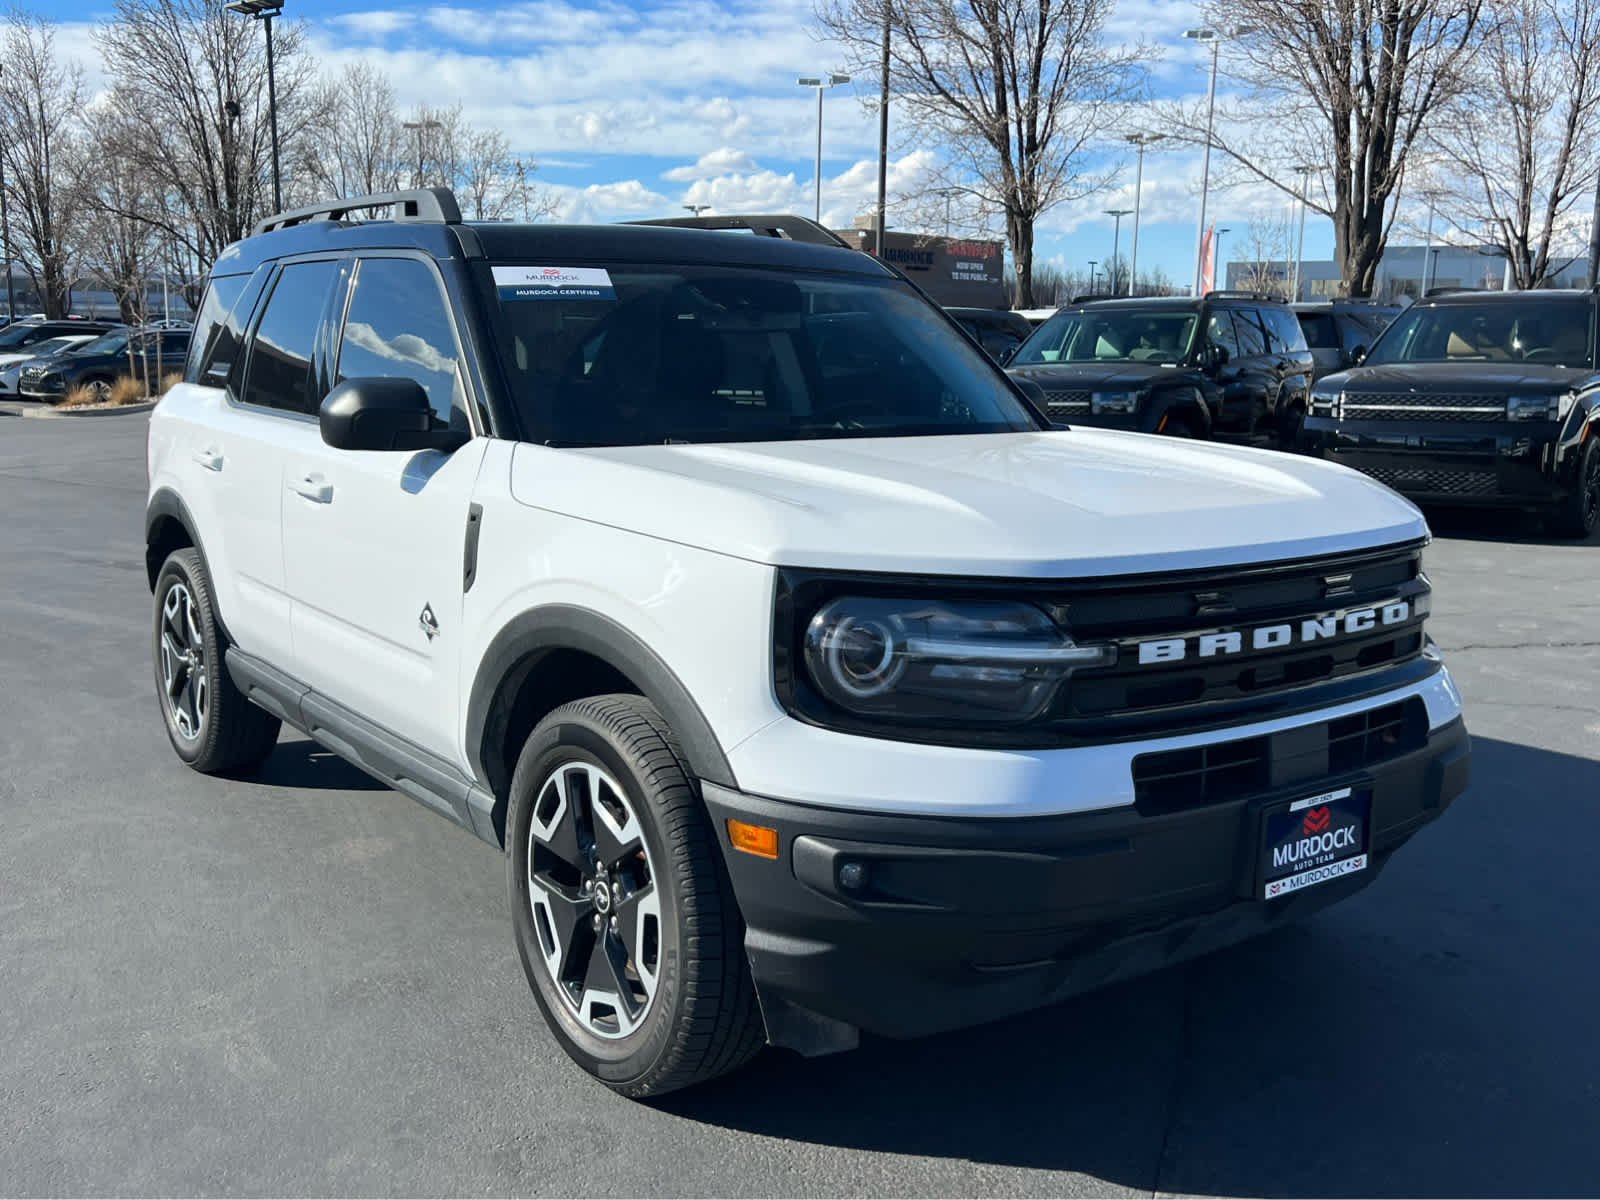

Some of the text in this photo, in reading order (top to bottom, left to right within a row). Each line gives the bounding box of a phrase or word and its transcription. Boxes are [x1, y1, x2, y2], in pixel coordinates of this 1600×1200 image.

[956, 262, 984, 271] NOW OPEN
[526, 274, 580, 282] MURDOCK
[952, 271, 989, 281] TO THE PUBLIC
[560, 289, 600, 297] CERTIFIED
[1138, 601, 1409, 665] BRONCO
[1273, 825, 1355, 868] MURDOCK
[1294, 853, 1335, 872] AUTO TEAM
[1290, 863, 1345, 889] MURDOCK
